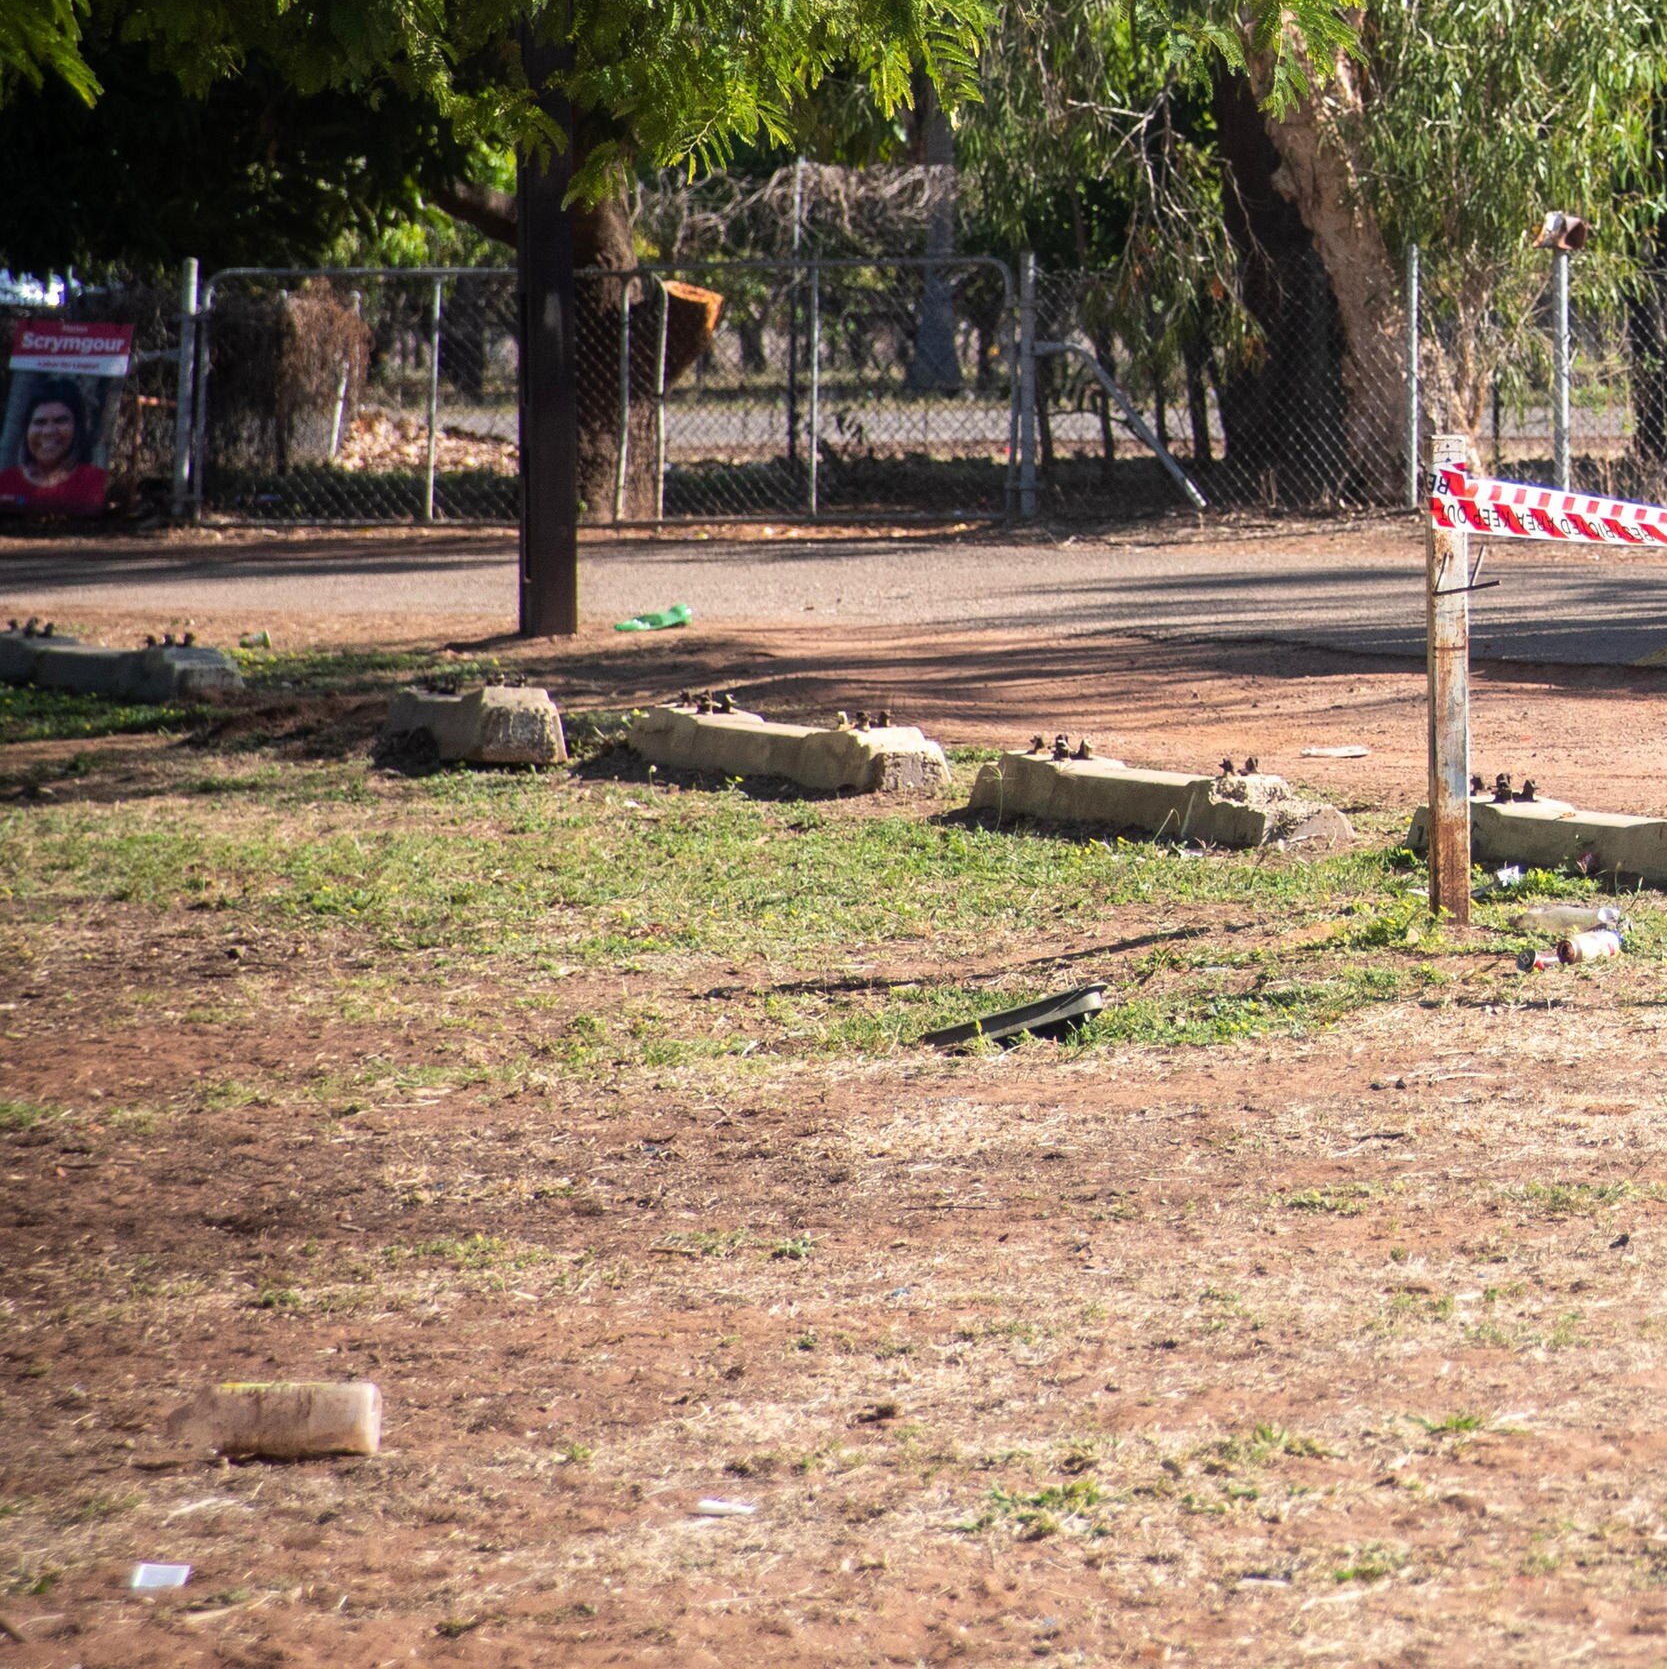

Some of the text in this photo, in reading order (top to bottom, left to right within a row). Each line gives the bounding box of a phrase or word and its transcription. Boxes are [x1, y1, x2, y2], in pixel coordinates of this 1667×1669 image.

[22, 332, 125, 352] Scrymgour
[1440, 504, 1657, 543] RESTRICTED AREA KEEP OUT
